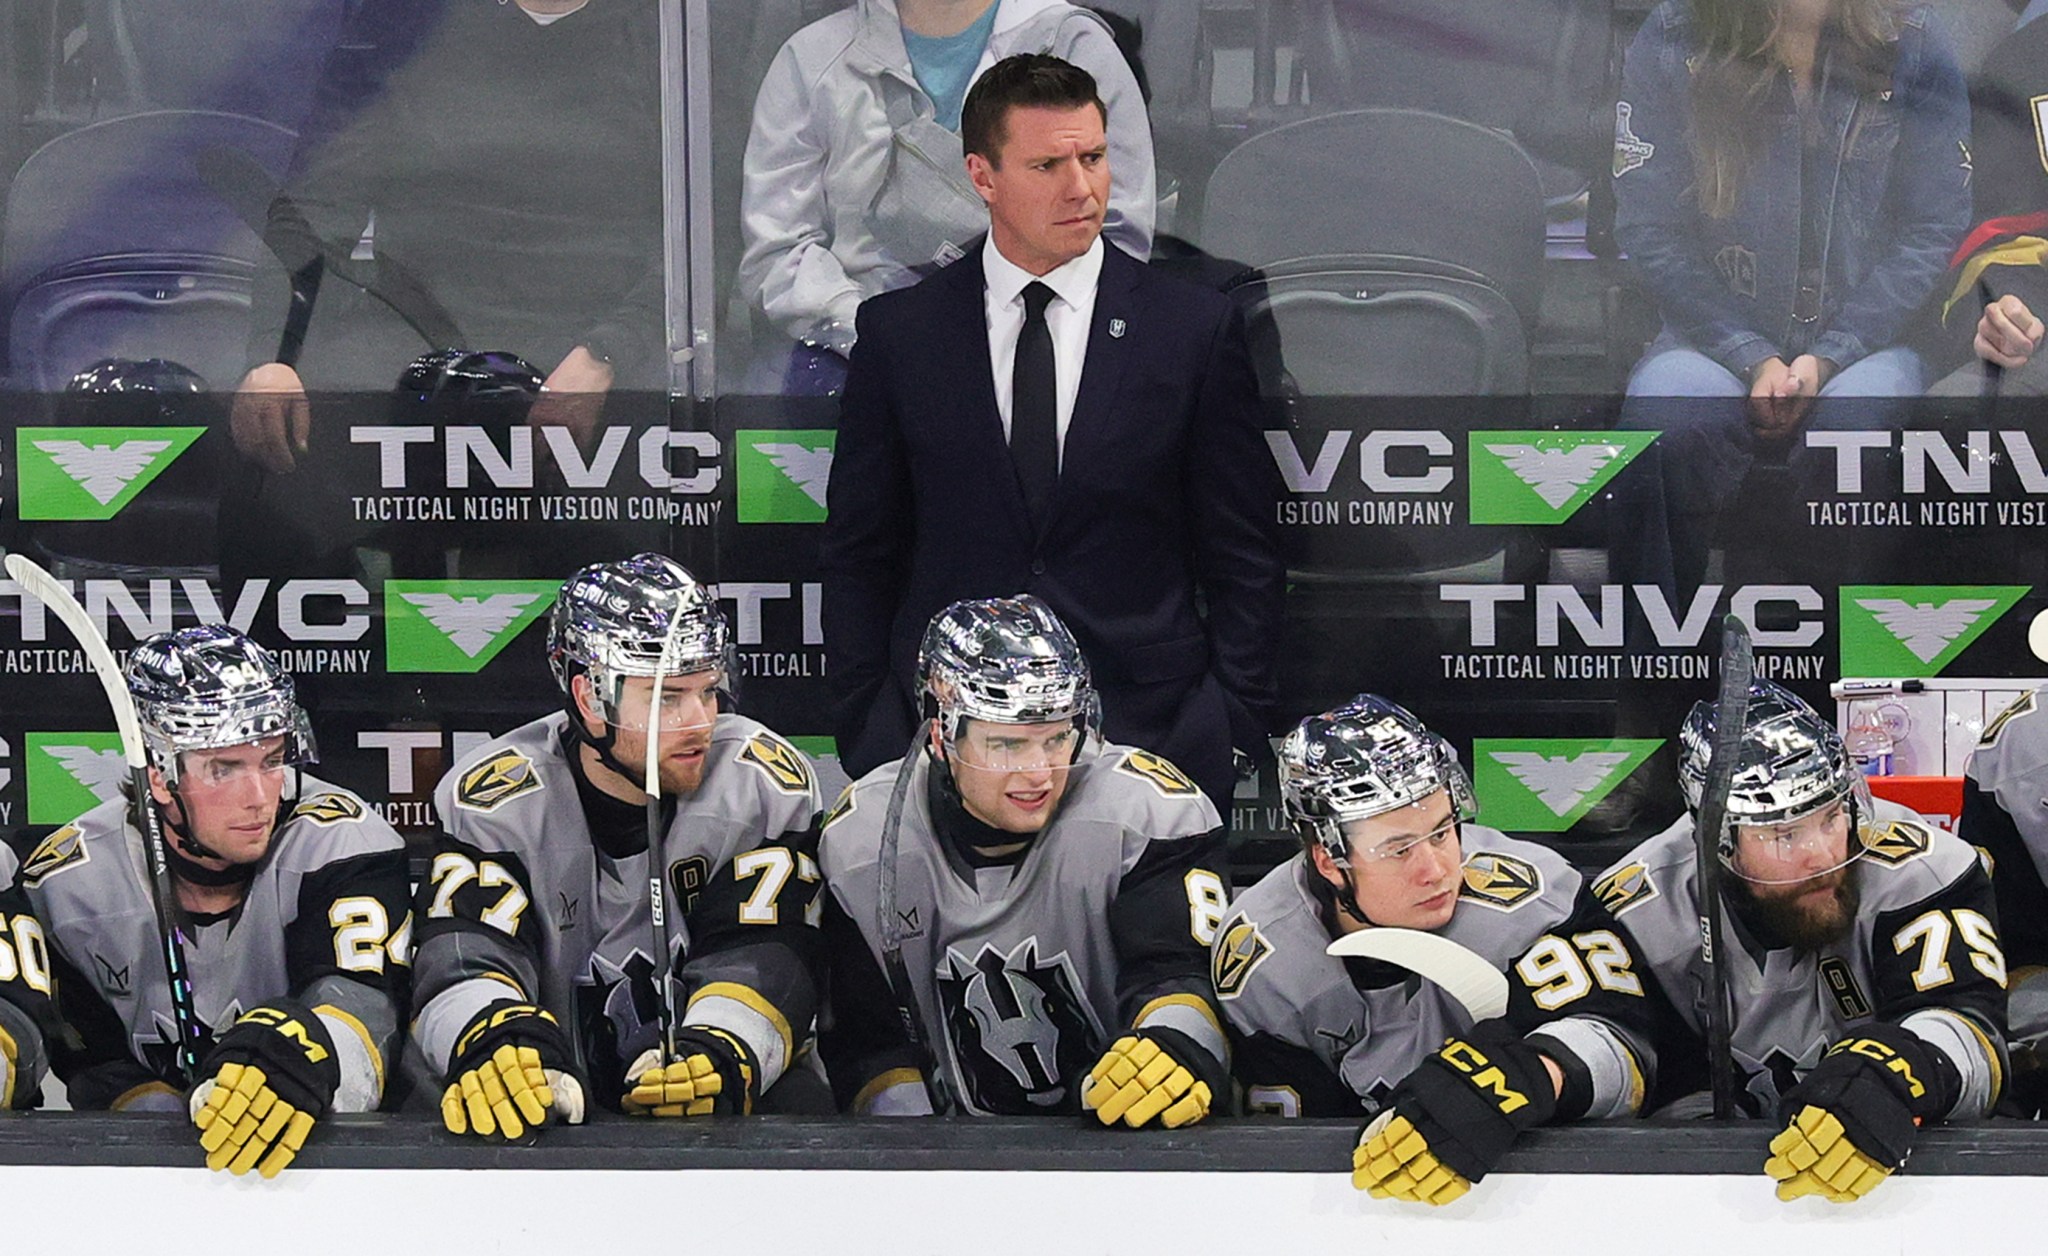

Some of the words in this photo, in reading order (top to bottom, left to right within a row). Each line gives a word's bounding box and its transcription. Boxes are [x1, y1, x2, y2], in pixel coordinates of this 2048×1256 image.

[350, 425, 721, 493] TNVC
[1264, 430, 1454, 493] VC
[1806, 430, 2048, 494] TNV
[352, 496, 455, 520] TACTICAL
[464, 496, 532, 520] NIGHT
[540, 496, 618, 521] VISION
[628, 496, 721, 526] COMPANY
[1349, 501, 1454, 525] COMPANY
[1806, 502, 1911, 526] TACTICAL
[1921, 502, 1989, 526] NIGHT
[1997, 502, 2047, 526] VISI
[0, 579, 370, 641] TNVC
[573, 581, 609, 606] SMI
[1440, 584, 1824, 647] TNVC
[1440, 655, 1545, 679] TACTICAL
[1554, 655, 1622, 679] NIGHT
[1630, 655, 1709, 679] VISION
[1718, 655, 1824, 680] MPANY
[427, 852, 529, 936] 77
[651, 881, 662, 923] CCM
[1183, 867, 1230, 947] 8
[1515, 929, 1646, 1011] 92
[1701, 920, 1711, 959] CCM
[1893, 908, 2009, 992] 75
[1817, 956, 1873, 1021] A
[1432, 1036, 1530, 1114] CM
[1824, 1038, 1926, 1099] CCM
